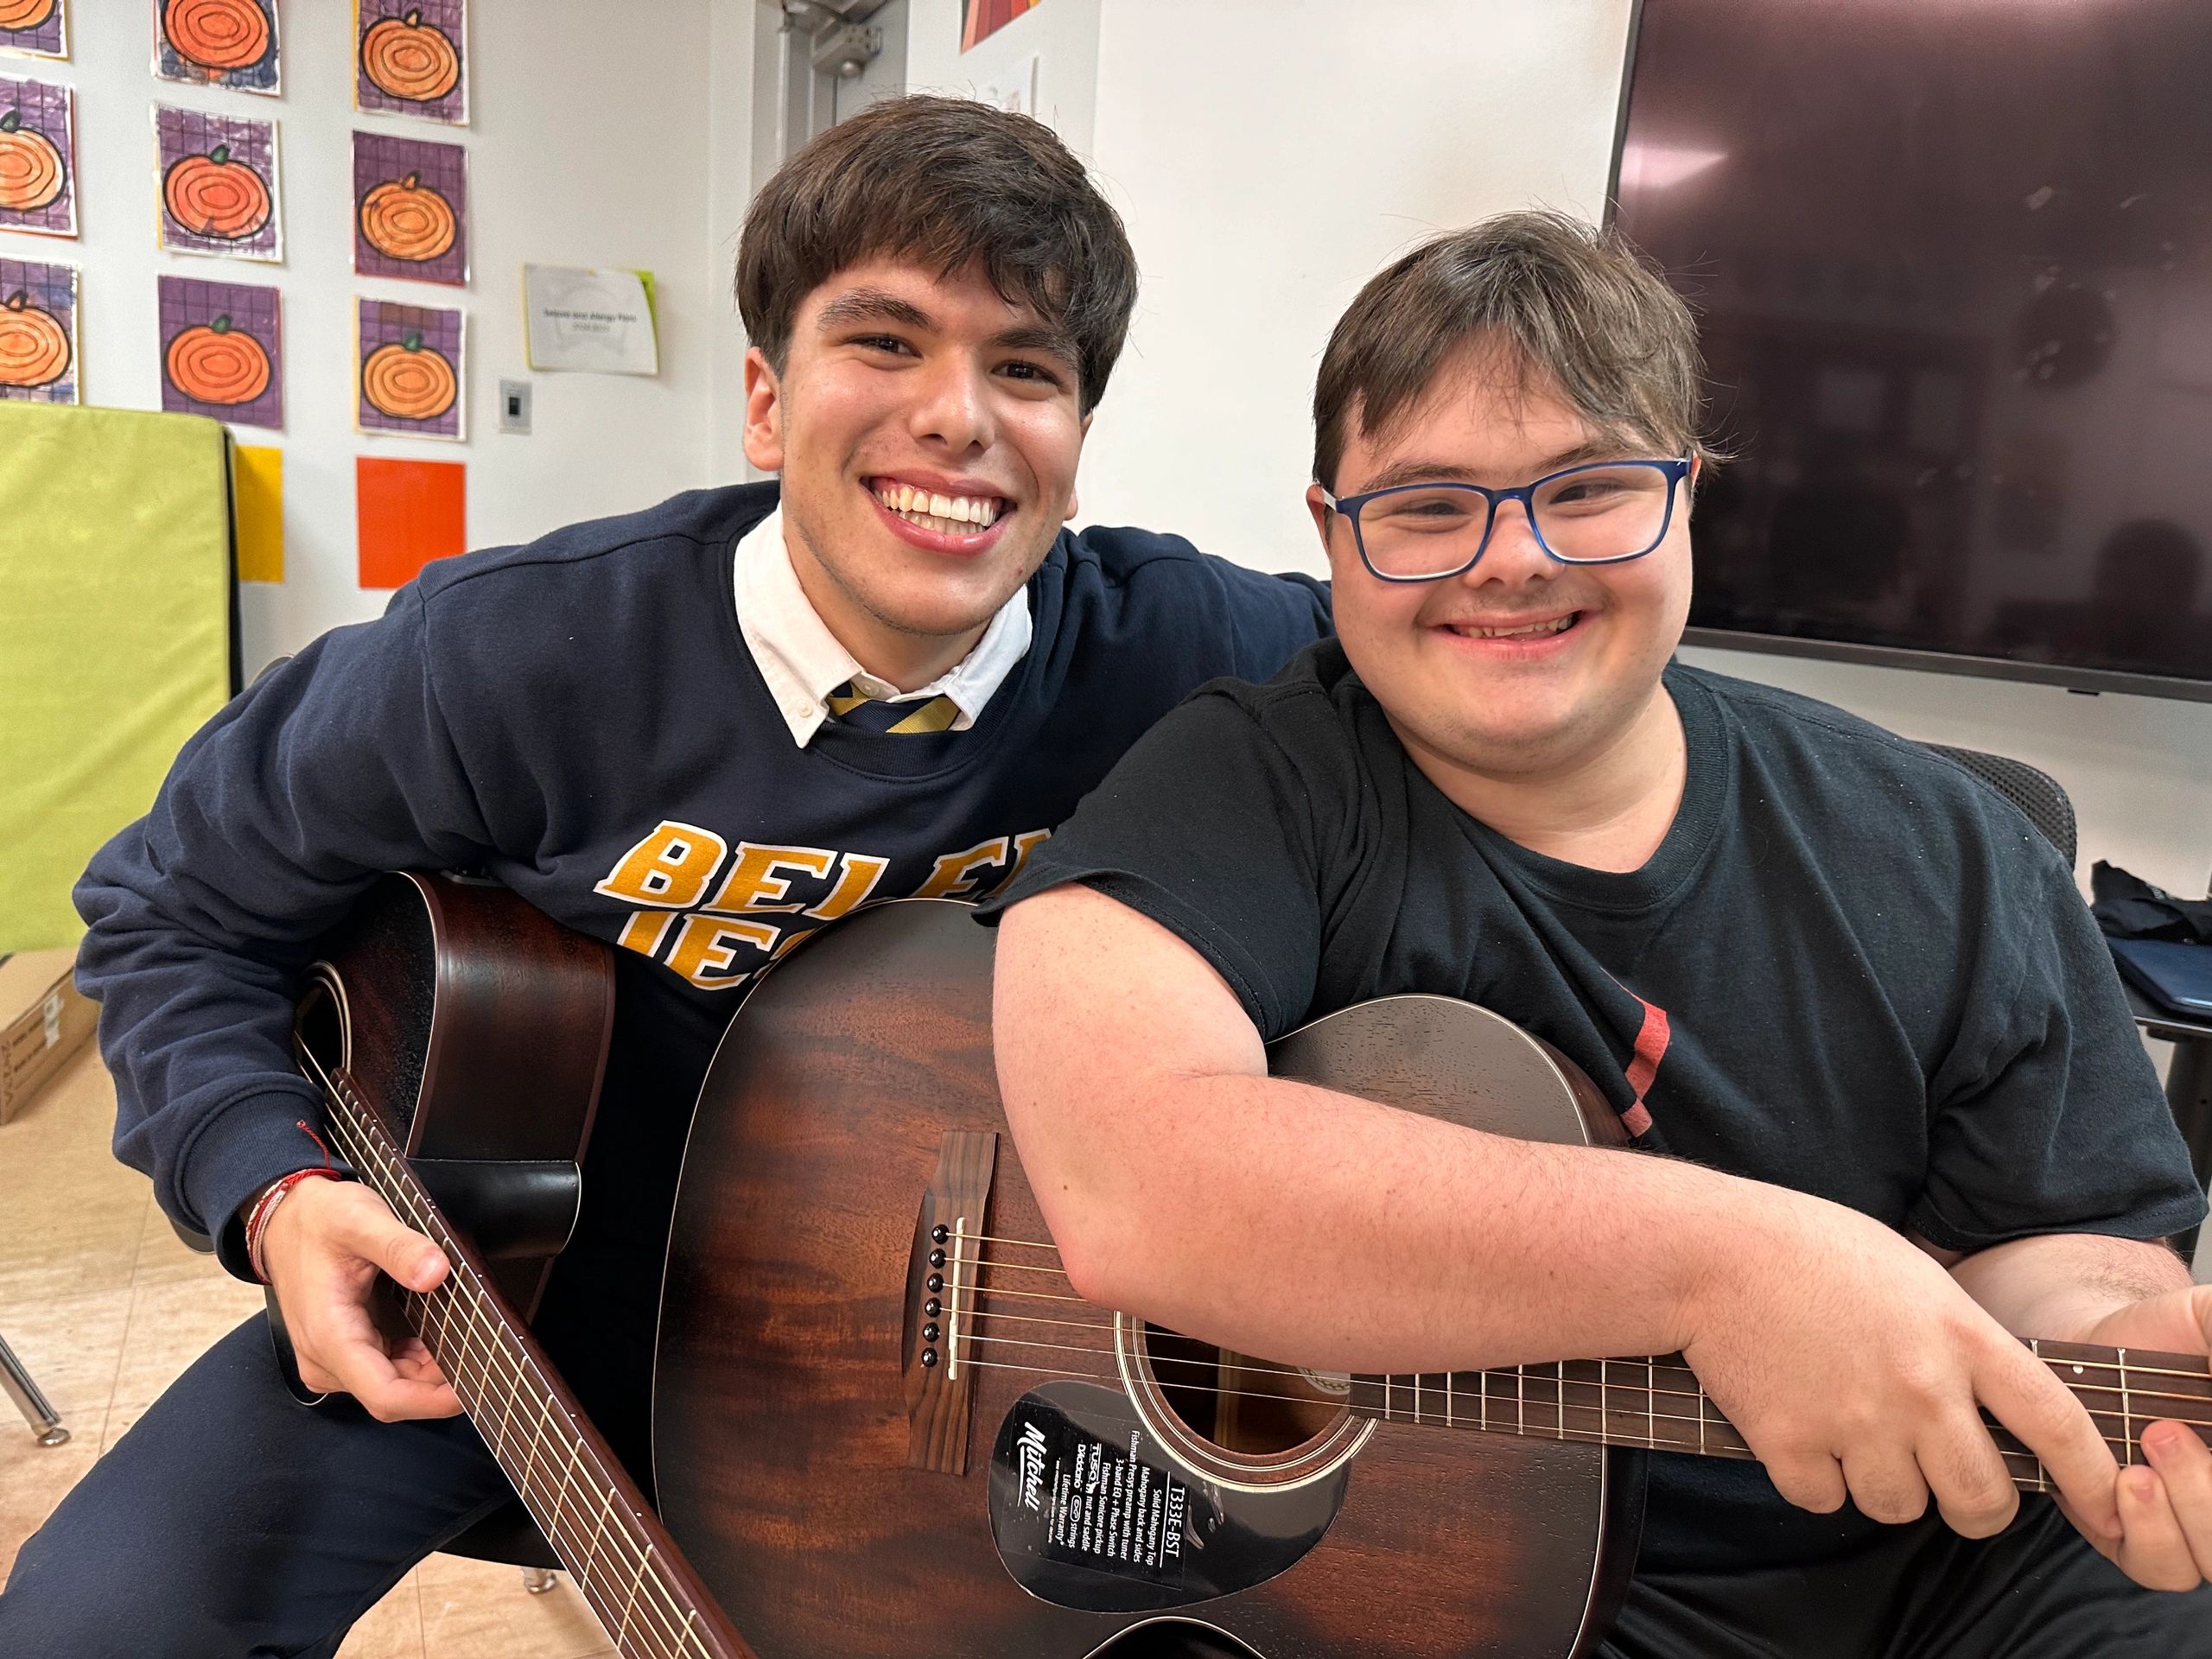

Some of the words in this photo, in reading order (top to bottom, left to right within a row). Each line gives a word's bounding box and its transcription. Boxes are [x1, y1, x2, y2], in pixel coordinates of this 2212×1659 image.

[1129, 1430, 1140, 1463] Fishman
[1016, 1421, 1047, 1511] Mitchell
[1089, 1443, 1098, 1481] TUSQ
[1115, 1459, 1124, 1487] 3-band
[1060, 1474, 1071, 1505] Lifetime
[1100, 1462, 1111, 1495] Fishman
[1126, 1464, 1137, 1489] Presys
[1138, 1466, 1150, 1508] Mahogany
[1112, 1488, 1122, 1498] EQ
[1123, 1490, 1133, 1519] preamp
[1152, 1489, 1162, 1510] Solid
[1097, 1496, 1108, 1528] Sonicore
[1110, 1508, 1120, 1530] Phase
[1137, 1508, 1147, 1527] back
[1166, 1487, 1185, 1557] T333E-BST
[1068, 1522, 1077, 1548] strings
[1082, 1526, 1090, 1551] saddle
[1093, 1529, 1103, 1554] pickup
[1122, 1520, 1131, 1537] with
[1147, 1510, 1160, 1551] Mahogany
[1108, 1530, 1117, 1556] Switch
[1134, 1543, 1142, 1563] sides
[1145, 1552, 1156, 1566] Top
